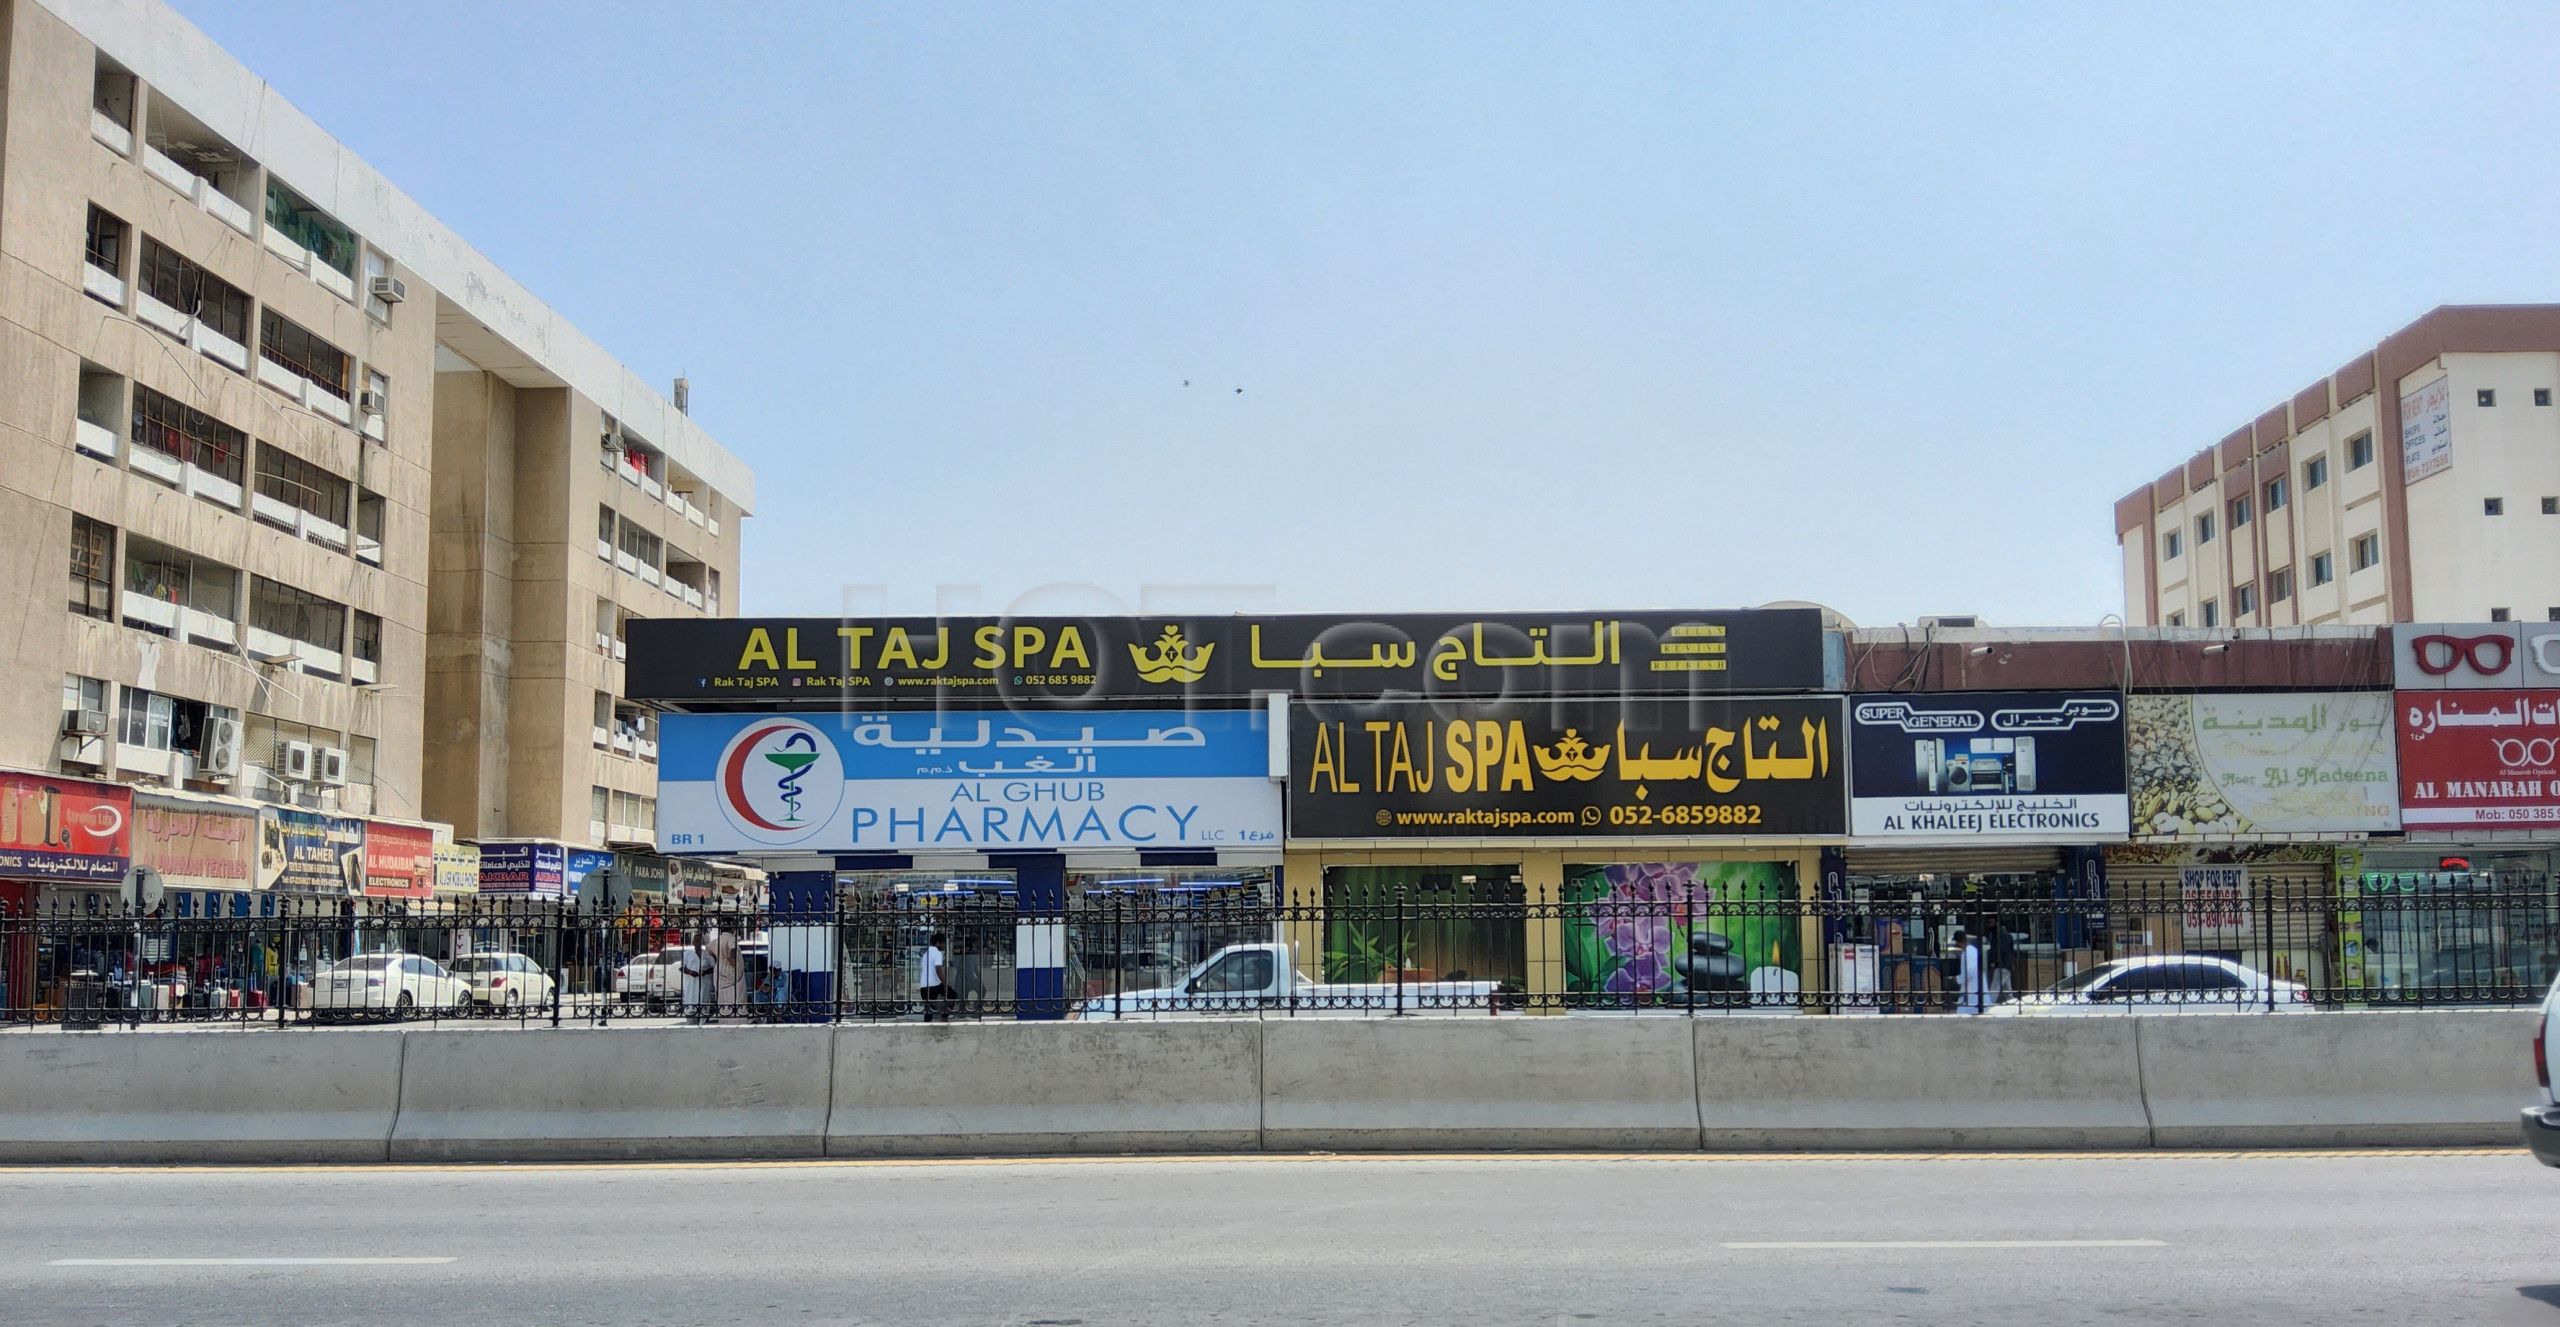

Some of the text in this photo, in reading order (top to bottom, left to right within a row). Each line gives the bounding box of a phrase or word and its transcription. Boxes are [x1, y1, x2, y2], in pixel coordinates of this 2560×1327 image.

[738, 626, 1091, 670] AL TAJ SPA
[1251, 620, 1621, 681] التاج سبا
[714, 677, 779, 689] Rak Taj SPA
[806, 677, 871, 689] Rak Taj SPA
[898, 675, 999, 688] www.raktajspa.com
[1026, 675, 1097, 685] 052 685 9882
[1861, 708, 1979, 728] SUPER GENERAL
[2409, 698, 2530, 734] المناره
[852, 714, 1206, 755] صيدلية
[1309, 719, 1534, 793] AL TAJ SPA
[1616, 714, 1829, 800] التاج سبا
[959, 755, 1096, 777] الغب
[2261, 767, 2290, 788] Al
[2296, 767, 2389, 787] Madeena
[950, 781, 1105, 802] AL GHUB
[2414, 782, 2439, 799] AL
[2446, 780, 2543, 798] MANARAH
[2017, 798, 2077, 810] الخليج
[852, 804, 1224, 843] PHARMACY LLC
[1396, 808, 1575, 827] www.raktajspa.com
[1609, 805, 1762, 825] 052-6859882
[1883, 813, 2100, 833] AL KHALEEJ ELECTRONICS
[2475, 810, 2505, 820] Mob:
[2509, 809, 2530, 819] 050
[2533, 808, 2554, 819] 385
[672, 833, 705, 845] BR 1
[293, 846, 334, 863] AL TAHER
[368, 854, 378, 869] AL
[368, 876, 409, 888] ELECTRONICS
[479, 872, 529, 881] AKBAR
[2222, 869, 2242, 887] RENT
